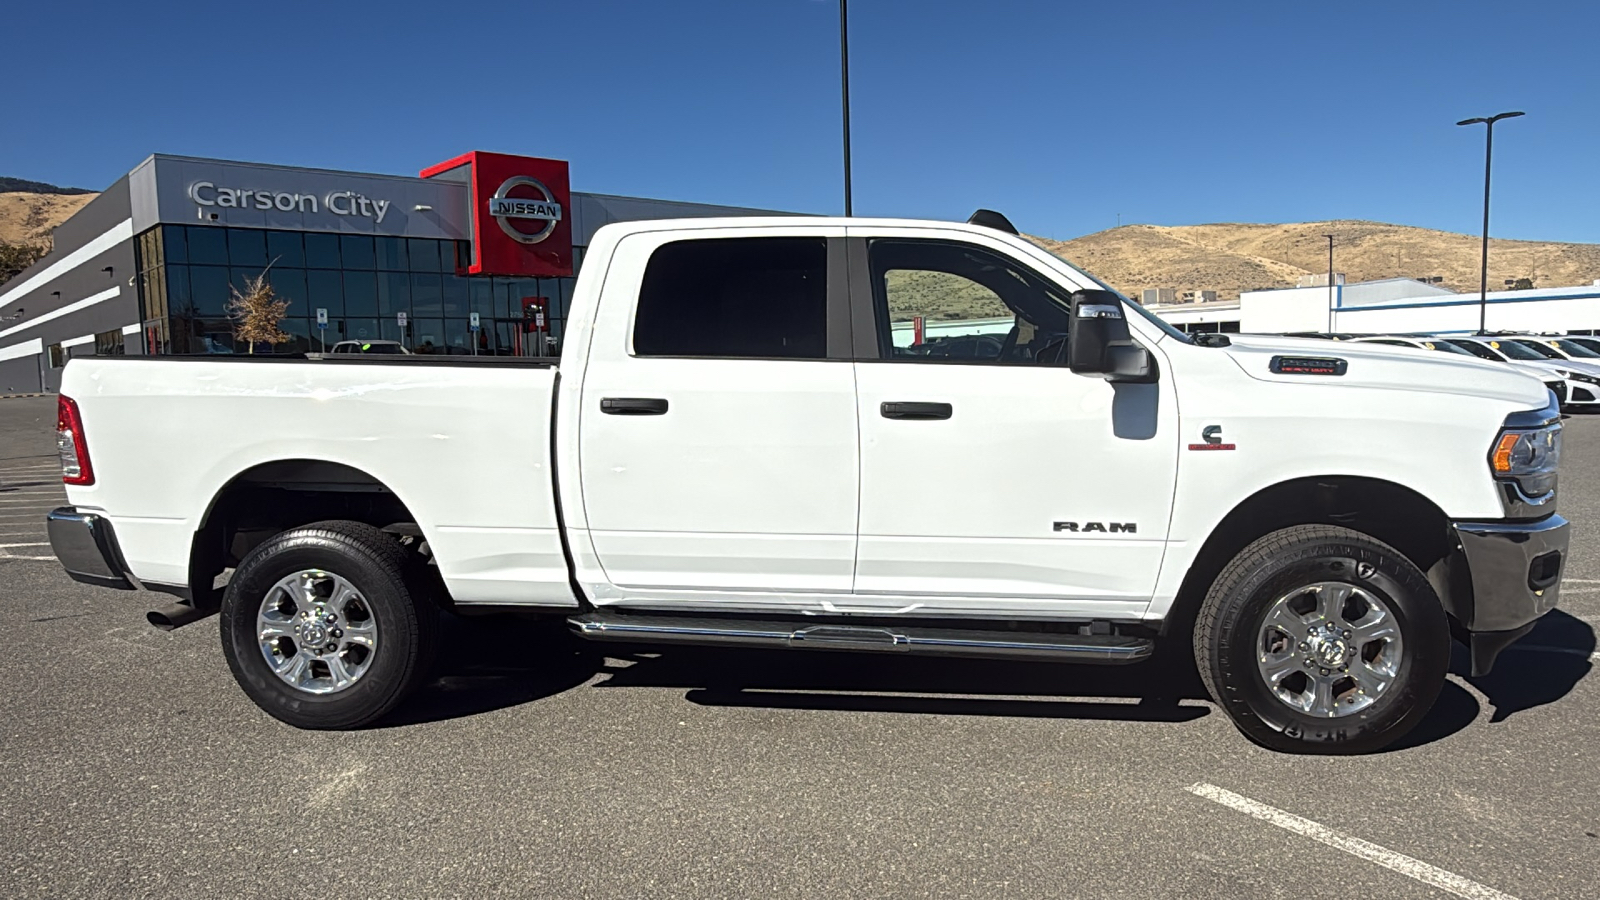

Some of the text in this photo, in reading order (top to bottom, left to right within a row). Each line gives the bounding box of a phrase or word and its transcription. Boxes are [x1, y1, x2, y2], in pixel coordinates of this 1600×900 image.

[189, 181, 391, 223] Carson City
[498, 202, 556, 217] NISSAN
[1053, 521, 1137, 533] RAM
